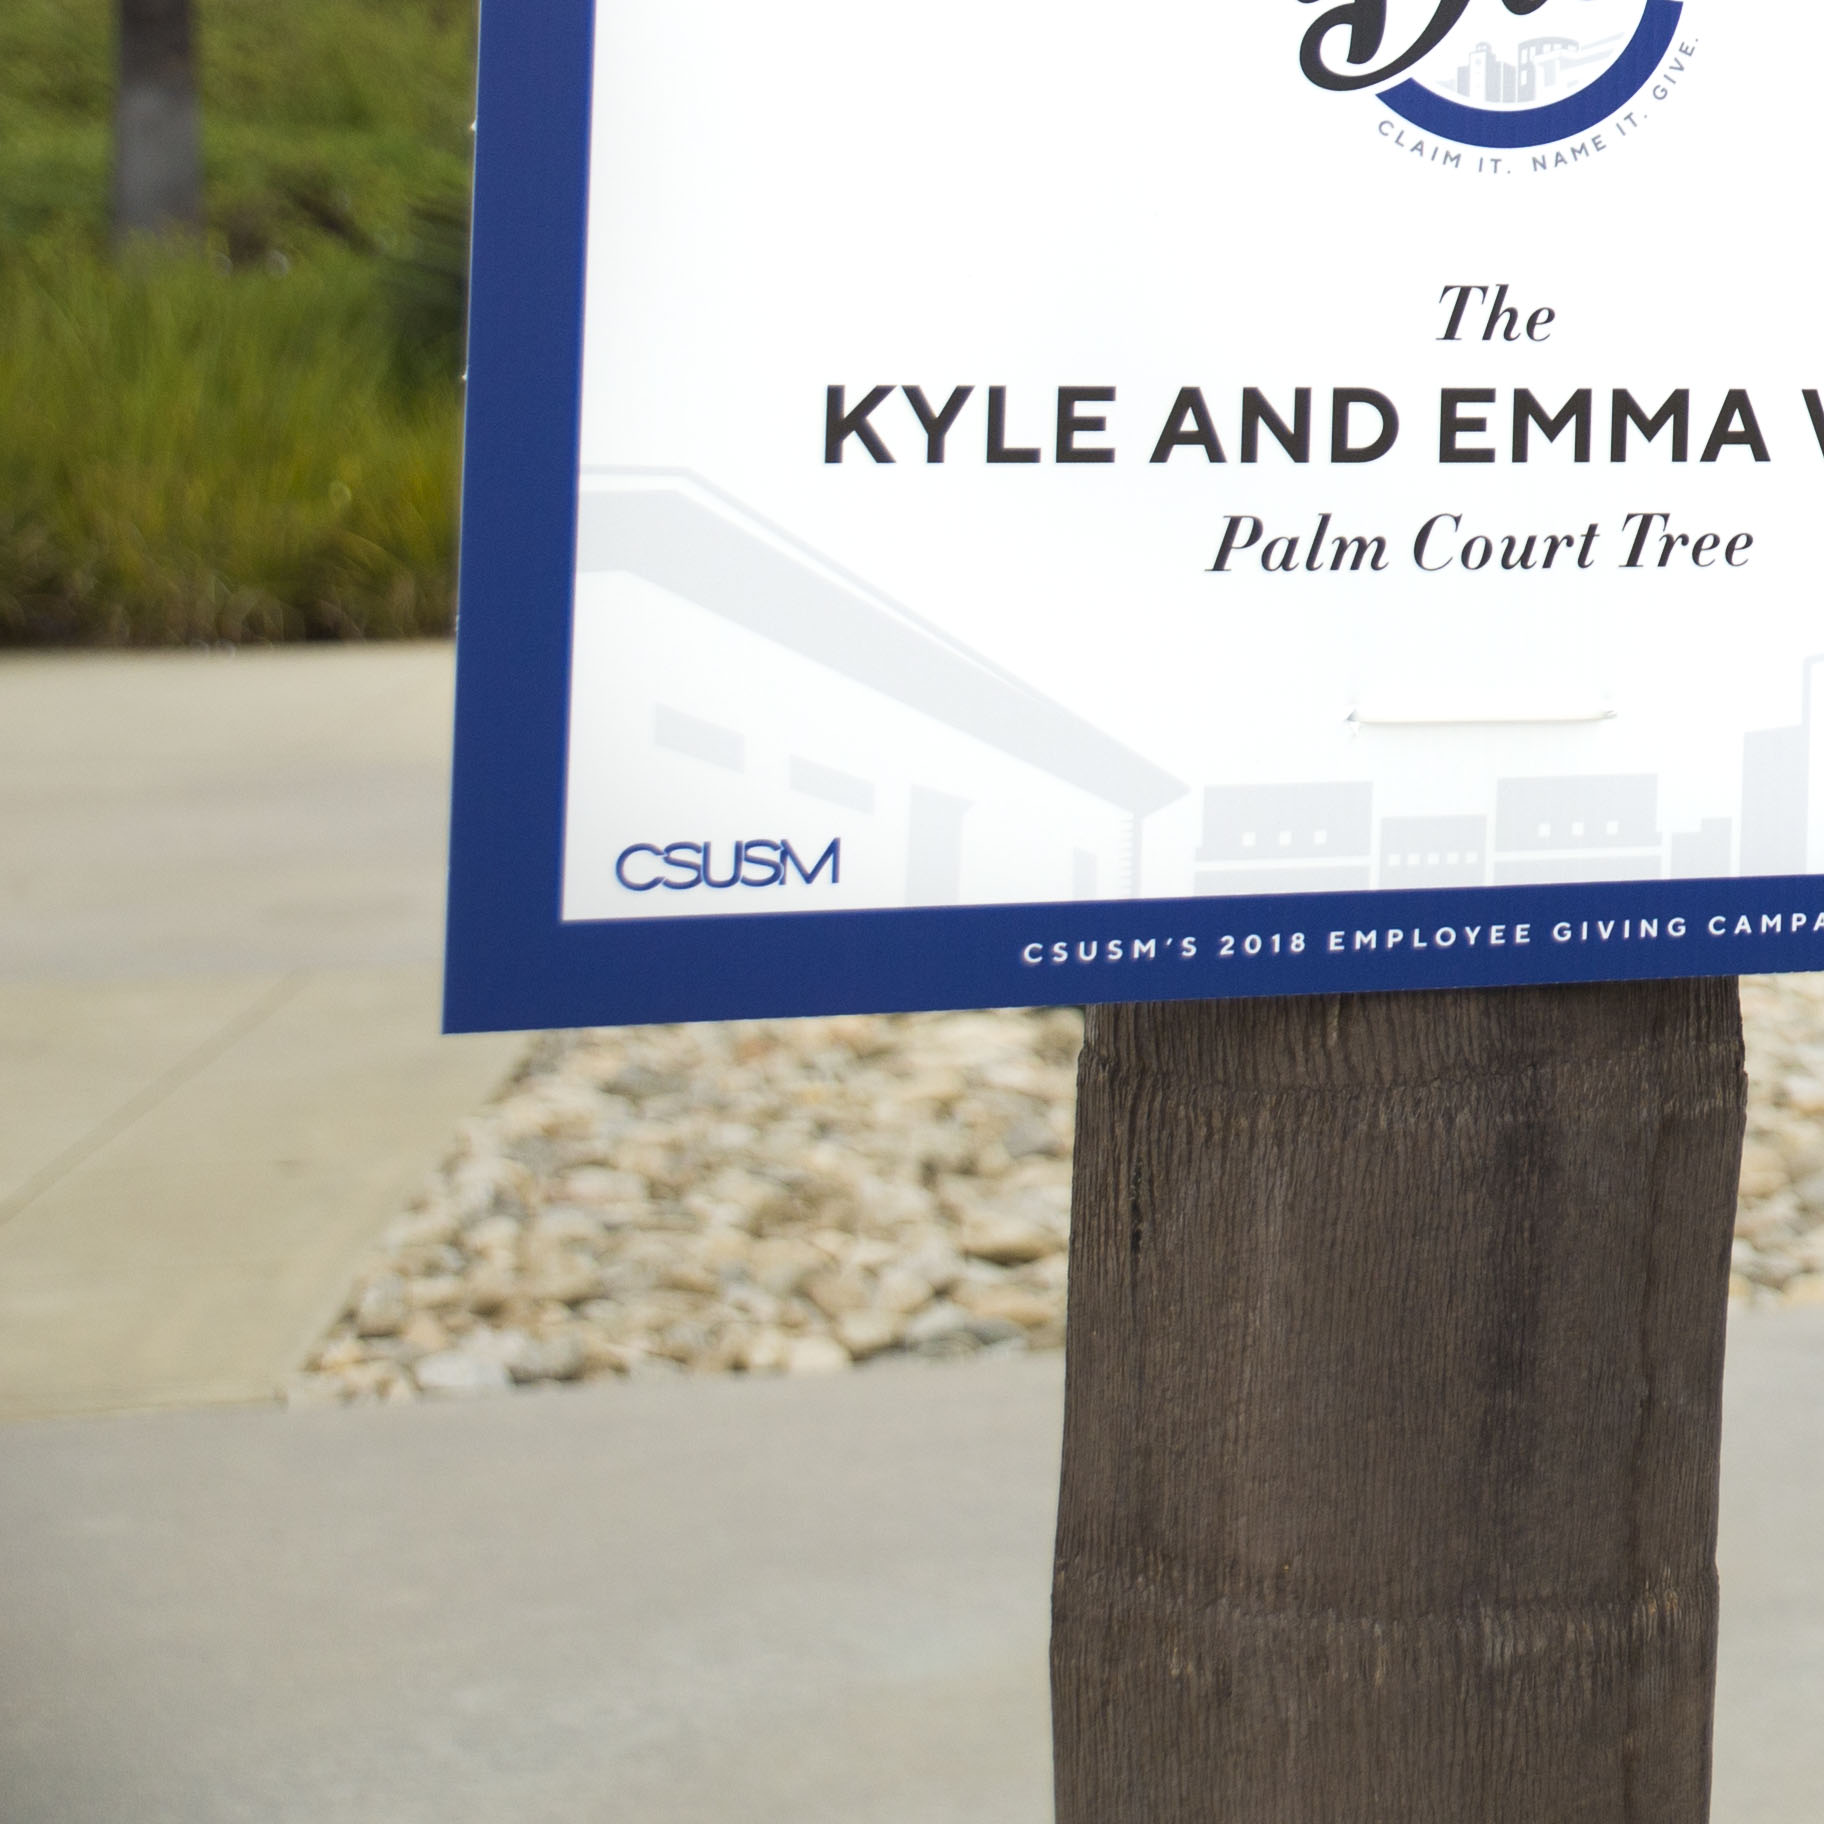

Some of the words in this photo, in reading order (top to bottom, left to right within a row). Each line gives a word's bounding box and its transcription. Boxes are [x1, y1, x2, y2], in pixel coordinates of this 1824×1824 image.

[1377, 119, 1462, 169] CLAIM
[1477, 157, 1512, 175] IT.
[1531, 134, 1608, 173] NAME
[1615, 111, 1649, 137] IT.
[1651, 37, 1700, 102] GIVE.
[1436, 283, 1556, 342] The
[824, 384, 1116, 464] KYLE
[1148, 386, 1400, 464] AND
[1438, 387, 1771, 464] EMMA
[1205, 513, 1389, 572] Palm
[1413, 513, 1600, 572] Court
[1619, 512, 1755, 568] Tree
[615, 837, 841, 892] CSUSM
[1023, 936, 1198, 964] CSUSM'S
[1219, 932, 1306, 956] 2018
[1328, 922, 1532, 953] EMPLOYEE
[1552, 916, 1687, 943] GIVING
